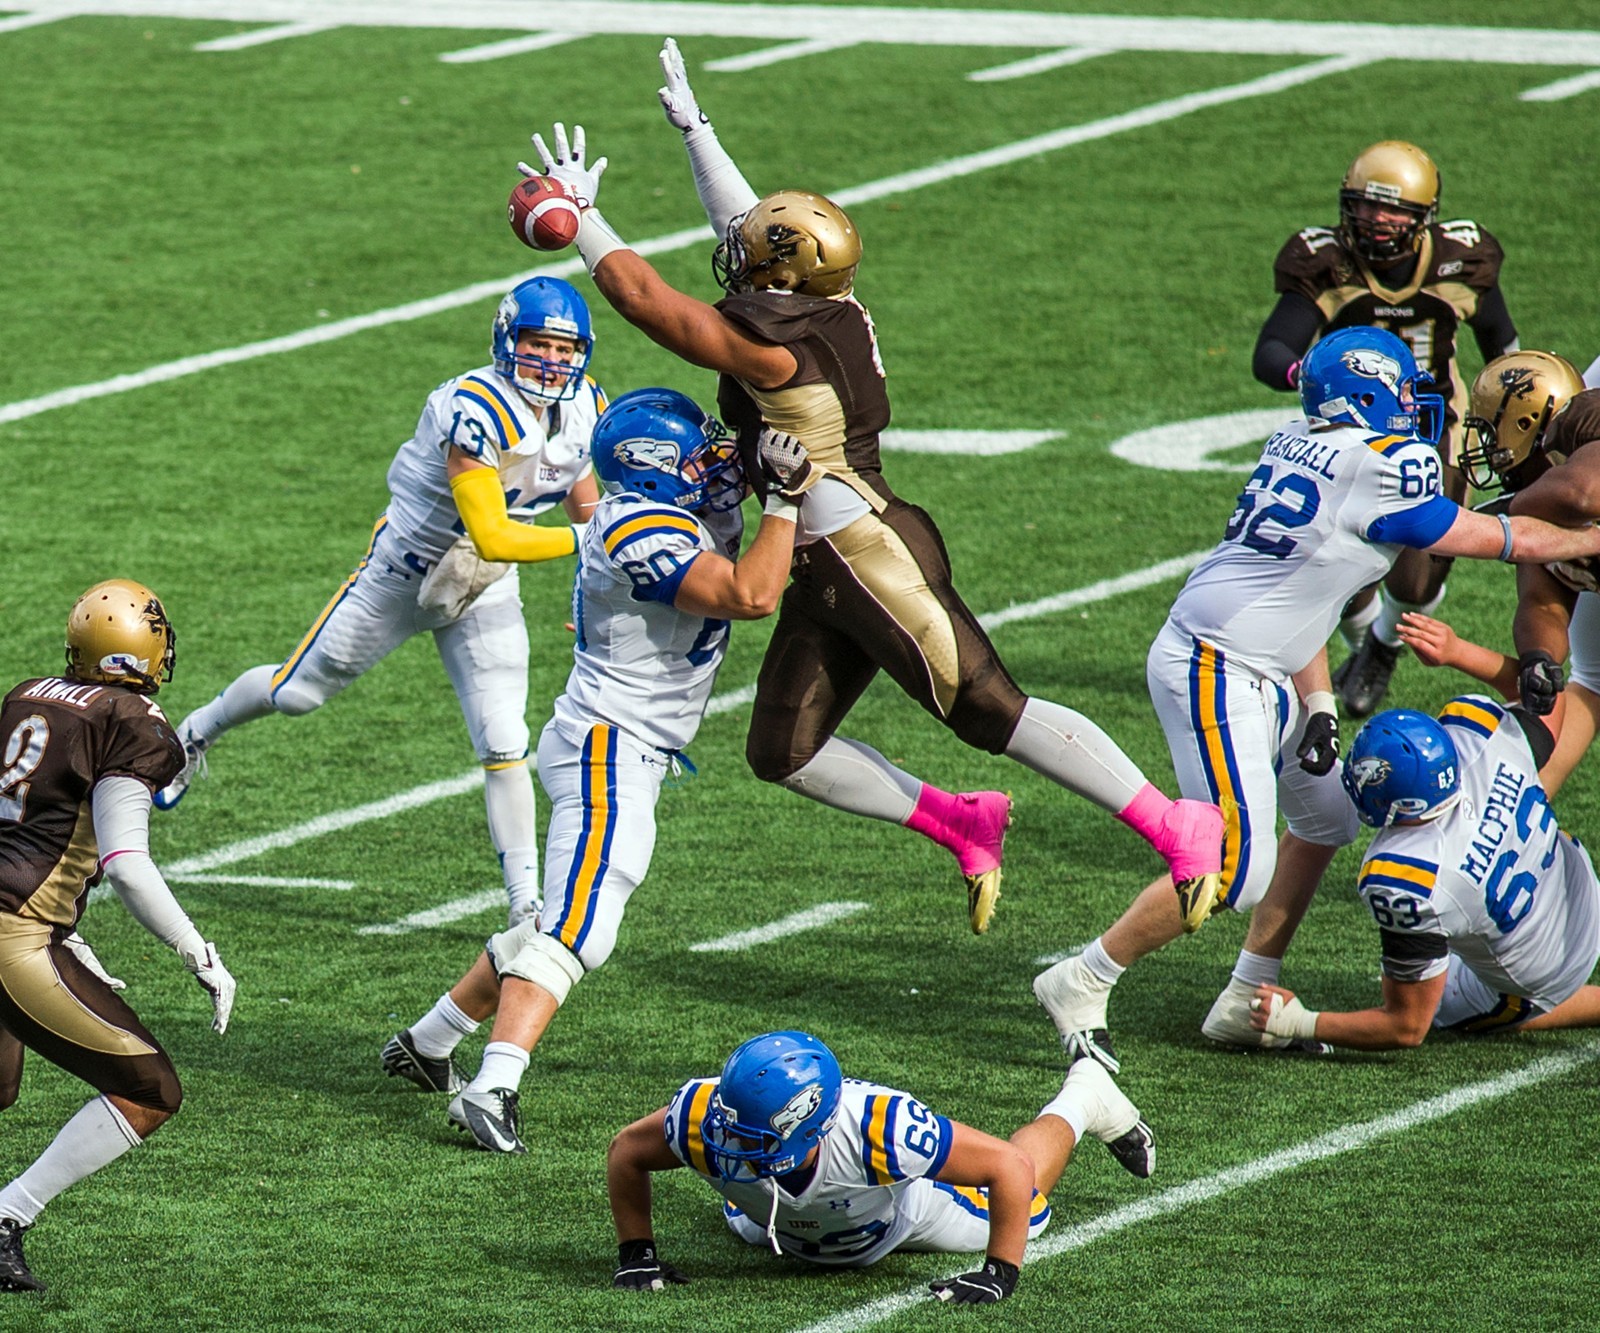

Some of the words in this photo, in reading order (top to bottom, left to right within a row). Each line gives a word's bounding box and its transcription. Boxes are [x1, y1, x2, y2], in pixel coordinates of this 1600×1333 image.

[1439, 219, 1481, 248] 41
[449, 410, 487, 457] 13
[538, 467, 561, 482] UBC
[1399, 455, 1438, 499] 62
[1223, 463, 1321, 560] 62
[621, 548, 684, 590] 60
[1438, 766, 1455, 790] 63
[1458, 762, 1525, 885] MACPHIE
[1484, 784, 1559, 934] 63
[1369, 893, 1423, 928] 63
[904, 1099, 942, 1160] 69
[788, 1219, 820, 1229] UBC
